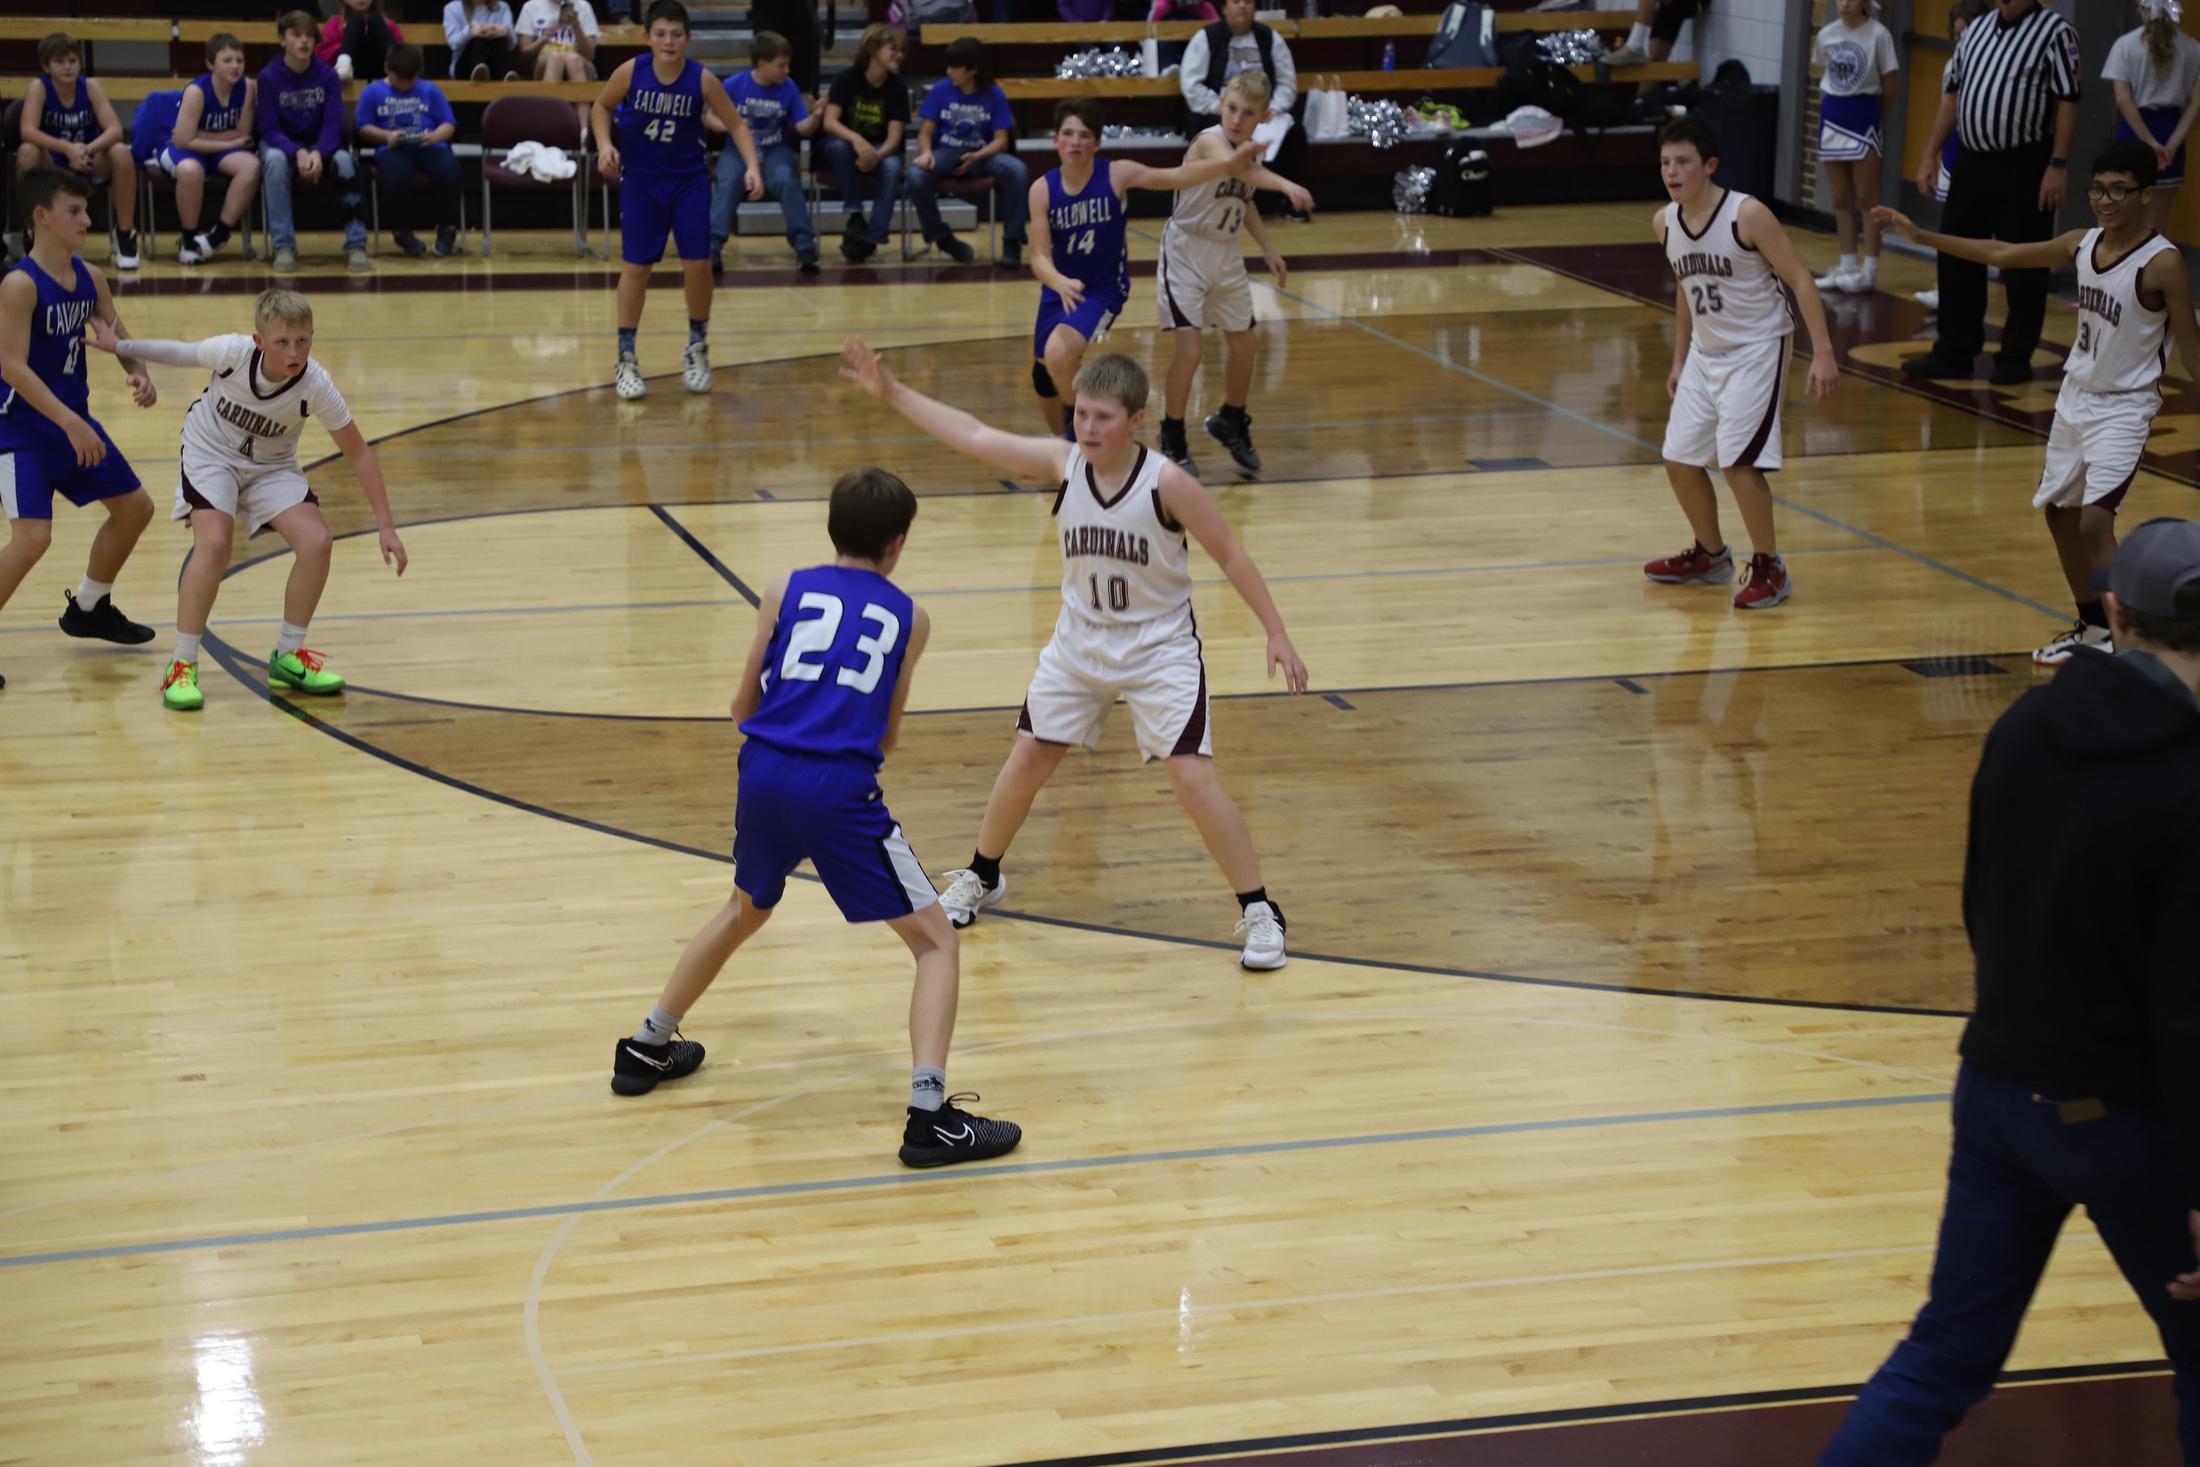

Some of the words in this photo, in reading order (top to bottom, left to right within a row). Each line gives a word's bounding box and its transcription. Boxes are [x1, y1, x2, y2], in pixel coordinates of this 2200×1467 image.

[634, 89, 692, 116] CALDWELL
[643, 118, 676, 143] 42
[1217, 207, 1242, 233] 13
[1066, 229, 1095, 254] 14
[1692, 284, 1724, 316] 25
[216, 396, 287, 438] CARDINALS
[1064, 525, 1149, 567] CARDINALS
[1088, 571, 1130, 612] 10
[780, 591, 900, 694] 23
